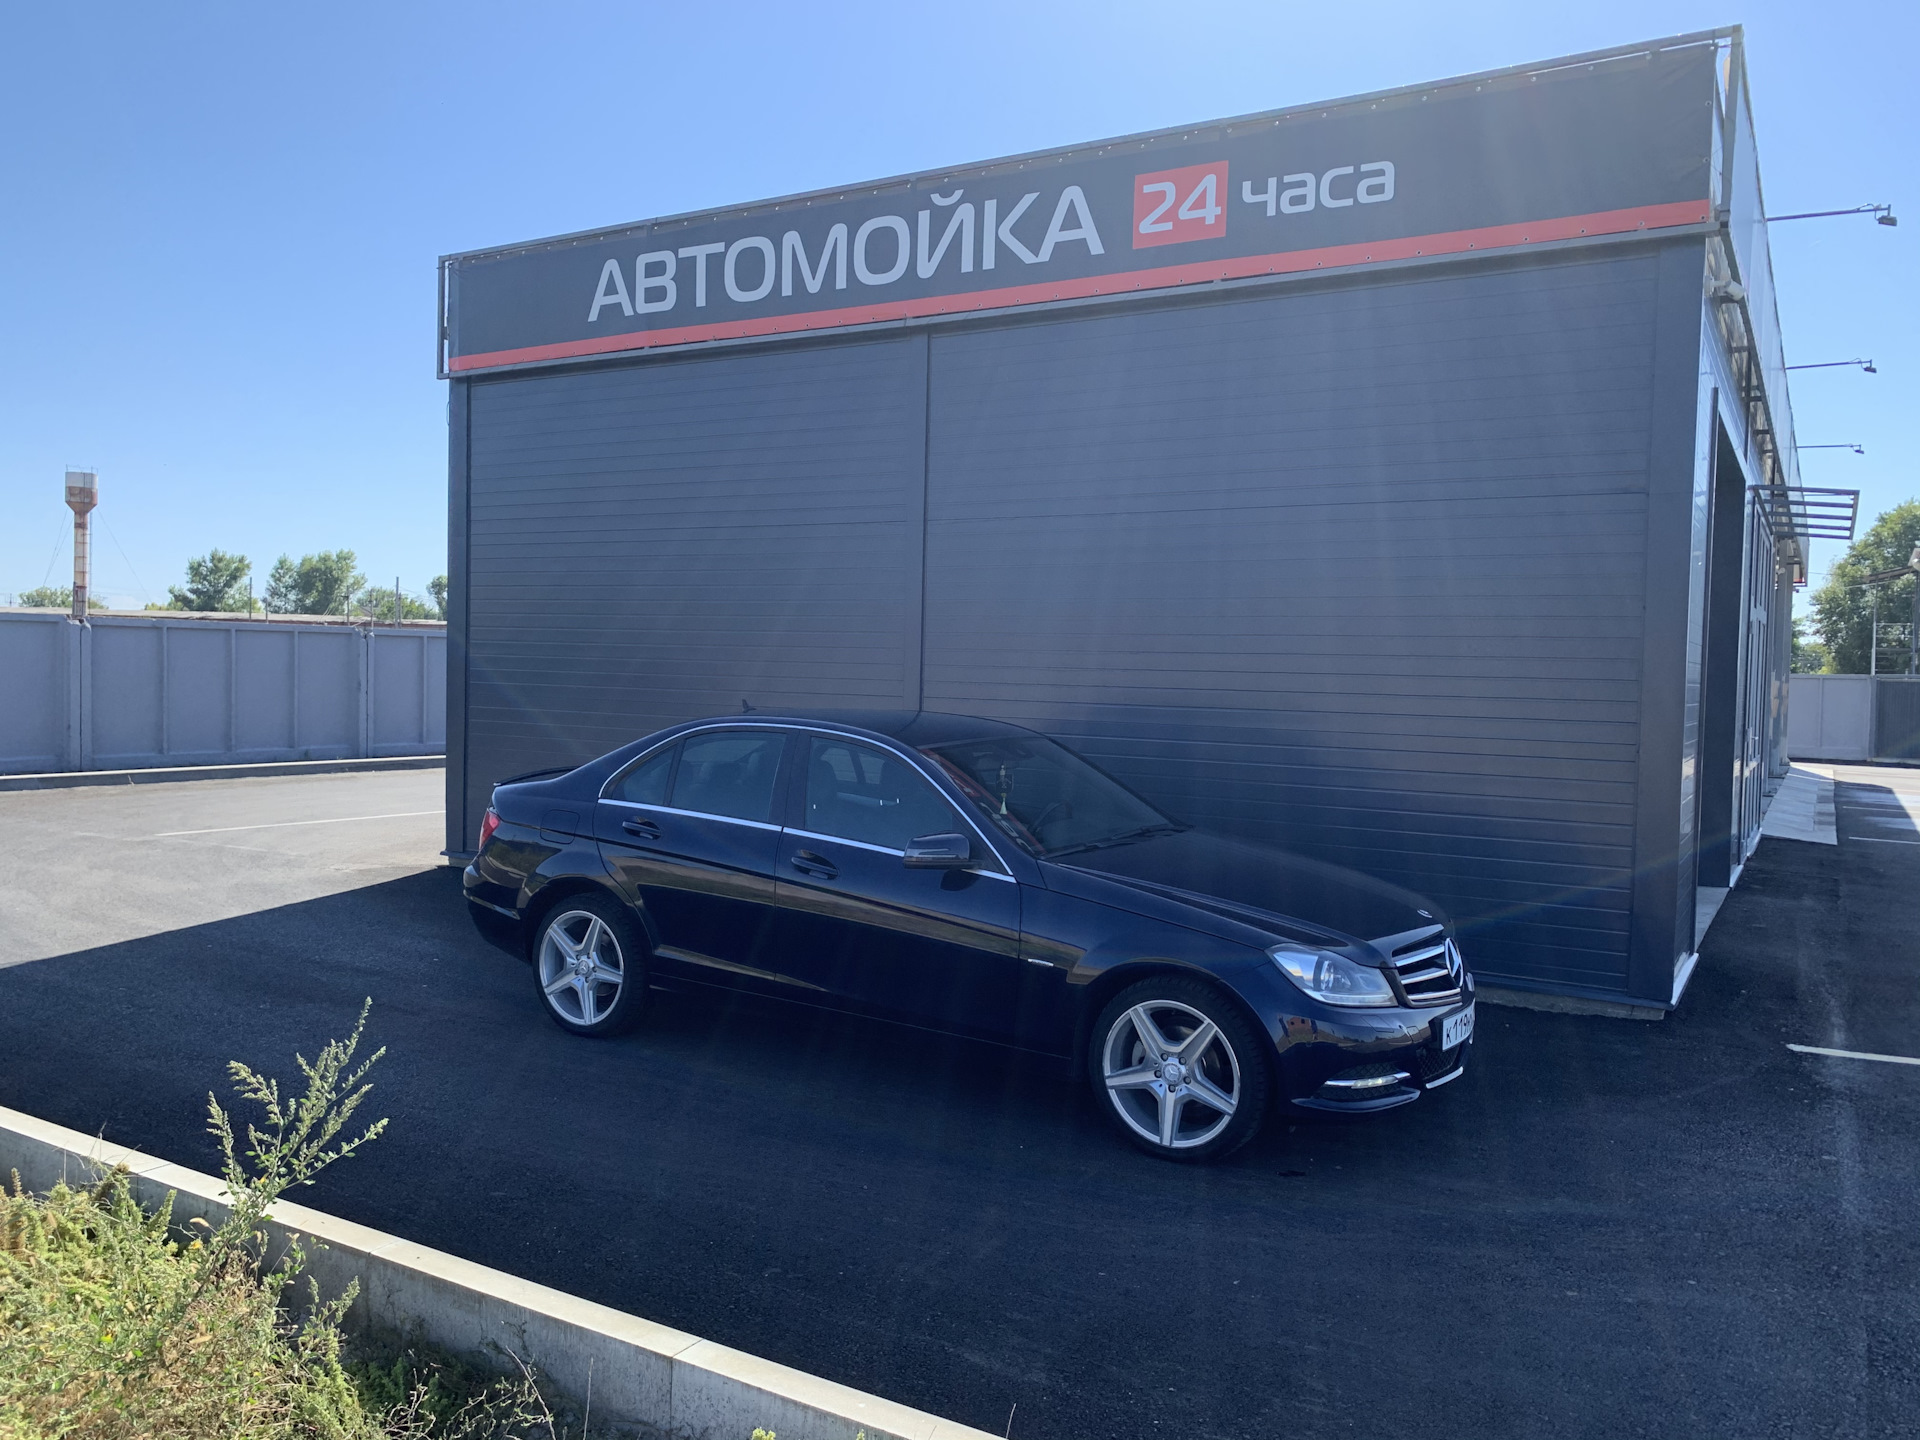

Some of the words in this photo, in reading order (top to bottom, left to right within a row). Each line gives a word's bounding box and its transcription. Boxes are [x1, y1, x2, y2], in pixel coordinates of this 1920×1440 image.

[588, 185, 1104, 322] АВТОМОЙКА
[1138, 173, 1222, 234] 24
[1242, 160, 1396, 217] часа
